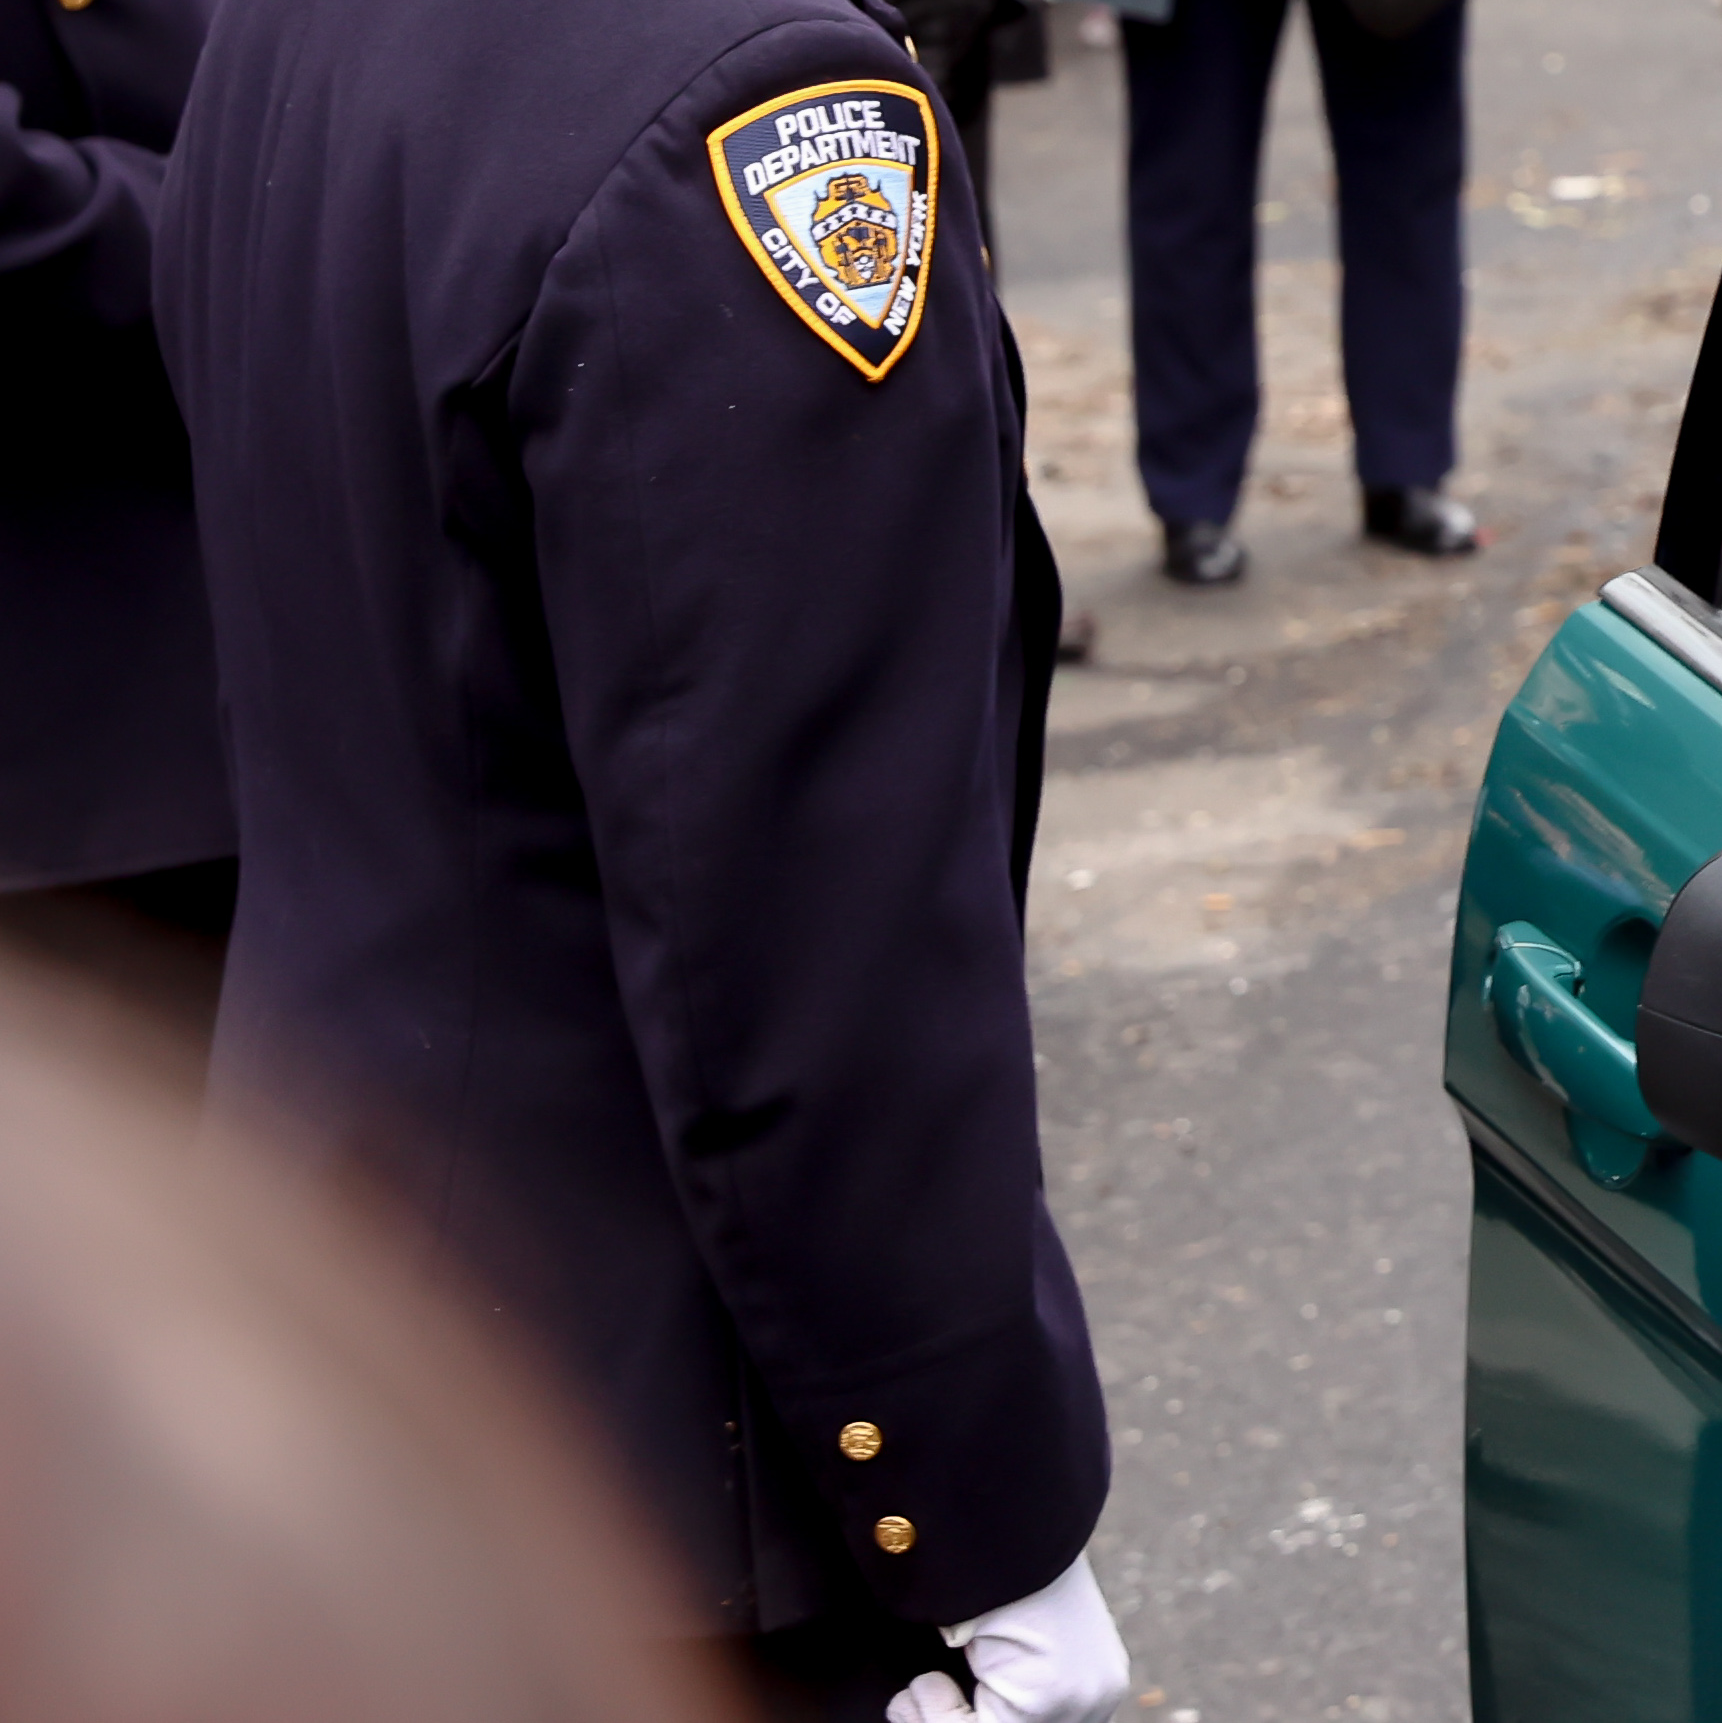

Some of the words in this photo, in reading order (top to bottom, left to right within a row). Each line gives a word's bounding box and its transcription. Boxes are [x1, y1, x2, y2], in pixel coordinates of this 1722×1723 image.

[774, 100, 885, 146] POLICE
[743, 130, 921, 196] DEPARTMENT
[761, 227, 820, 289] CITY
[815, 292, 857, 326] OF
[883, 276, 917, 336] NEW
[905, 191, 927, 267] YORK
